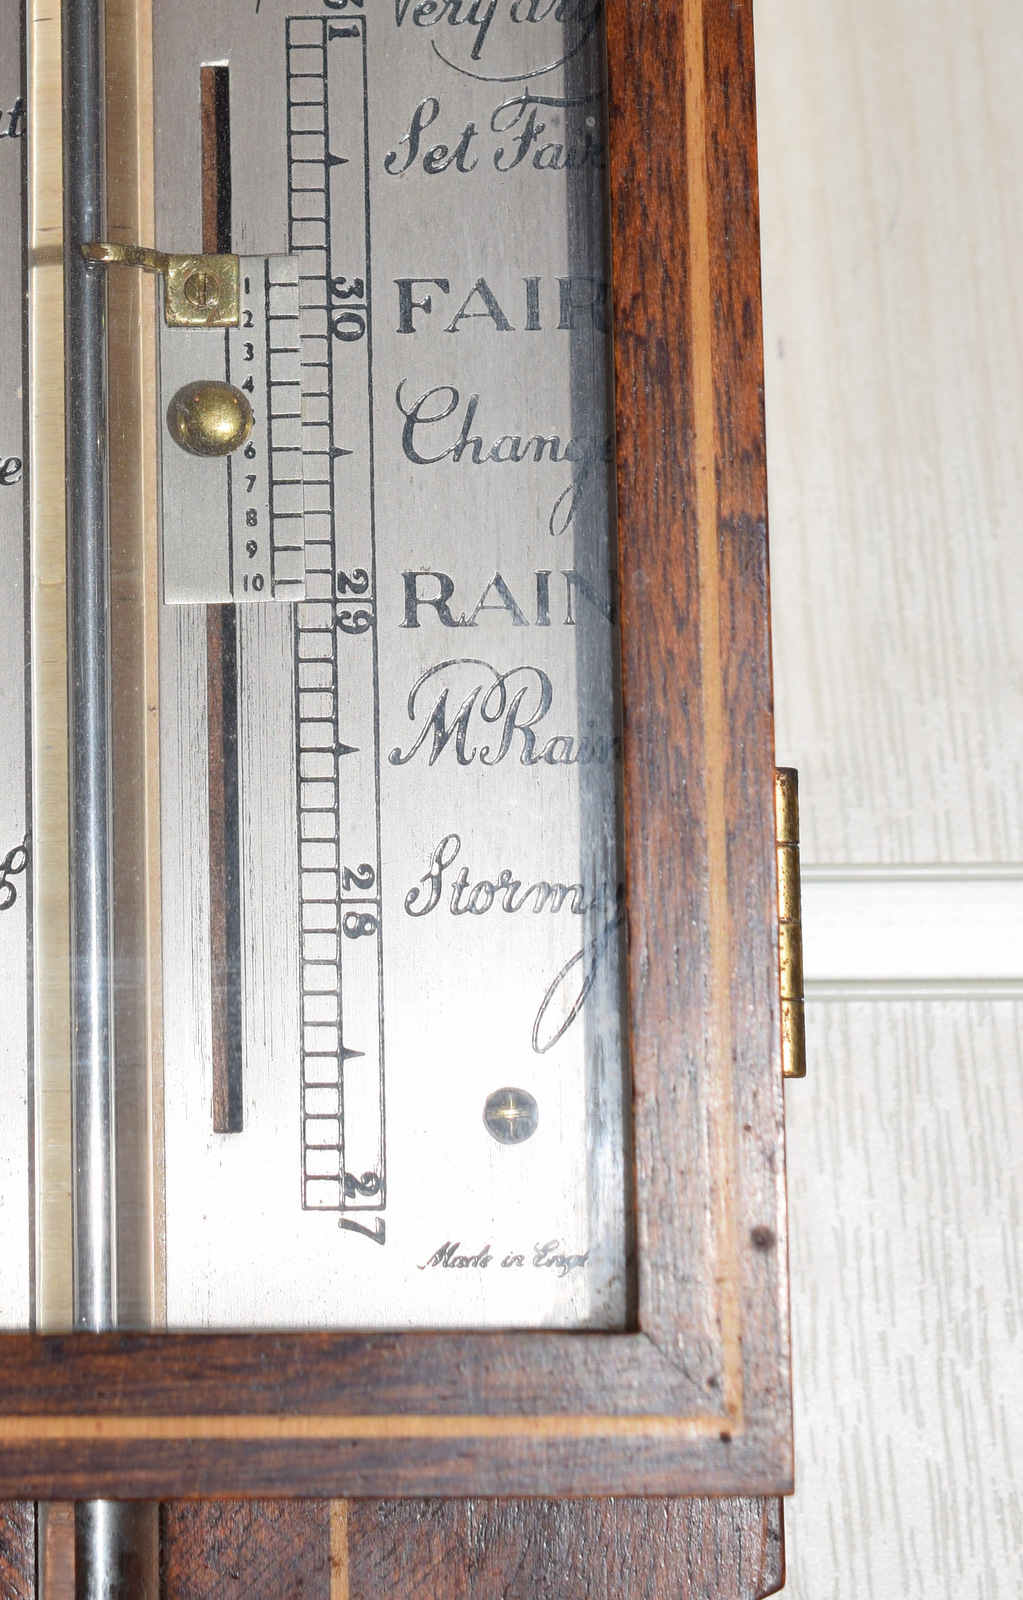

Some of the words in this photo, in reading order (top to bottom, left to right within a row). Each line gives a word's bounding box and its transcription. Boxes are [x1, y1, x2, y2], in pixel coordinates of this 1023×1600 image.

[384, 97, 479, 176] Set
[490, 86, 605, 172] Fair
[394, 276, 609, 334] FAIR
[242, 309, 254, 328] 2
[243, 342, 254, 361] 3
[241, 374, 255, 393] 4
[243, 441, 256, 459] 6
[245, 474, 256, 493] 7
[245, 507, 258, 527] 8
[245, 539, 258, 559] 9
[243, 573, 266, 593] 10
[398, 568, 619, 629] RAIN
[501, 1251, 525, 1269] in
